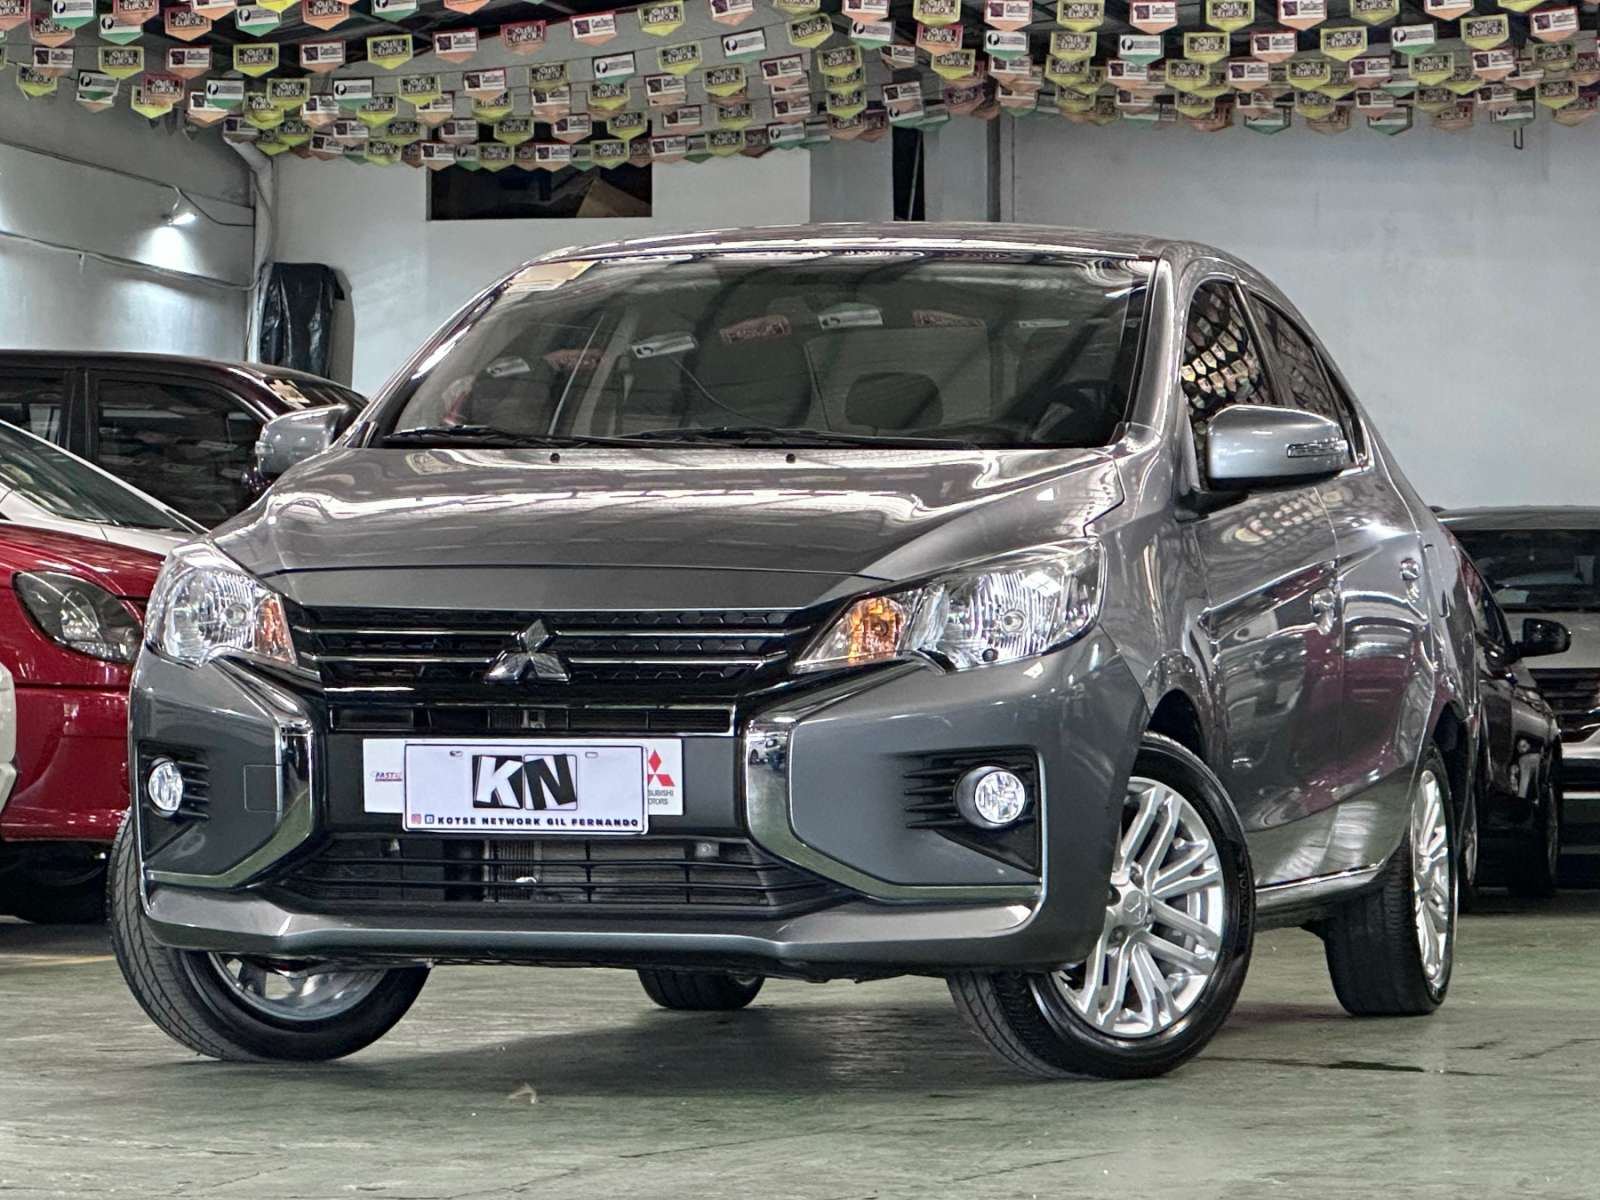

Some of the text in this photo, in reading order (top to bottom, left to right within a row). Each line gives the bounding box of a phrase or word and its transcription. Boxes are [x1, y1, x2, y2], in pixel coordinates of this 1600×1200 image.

[475, 754, 577, 811] KN
[437, 817, 639, 827] KOTSE NETWORK GIL FERNANDO
